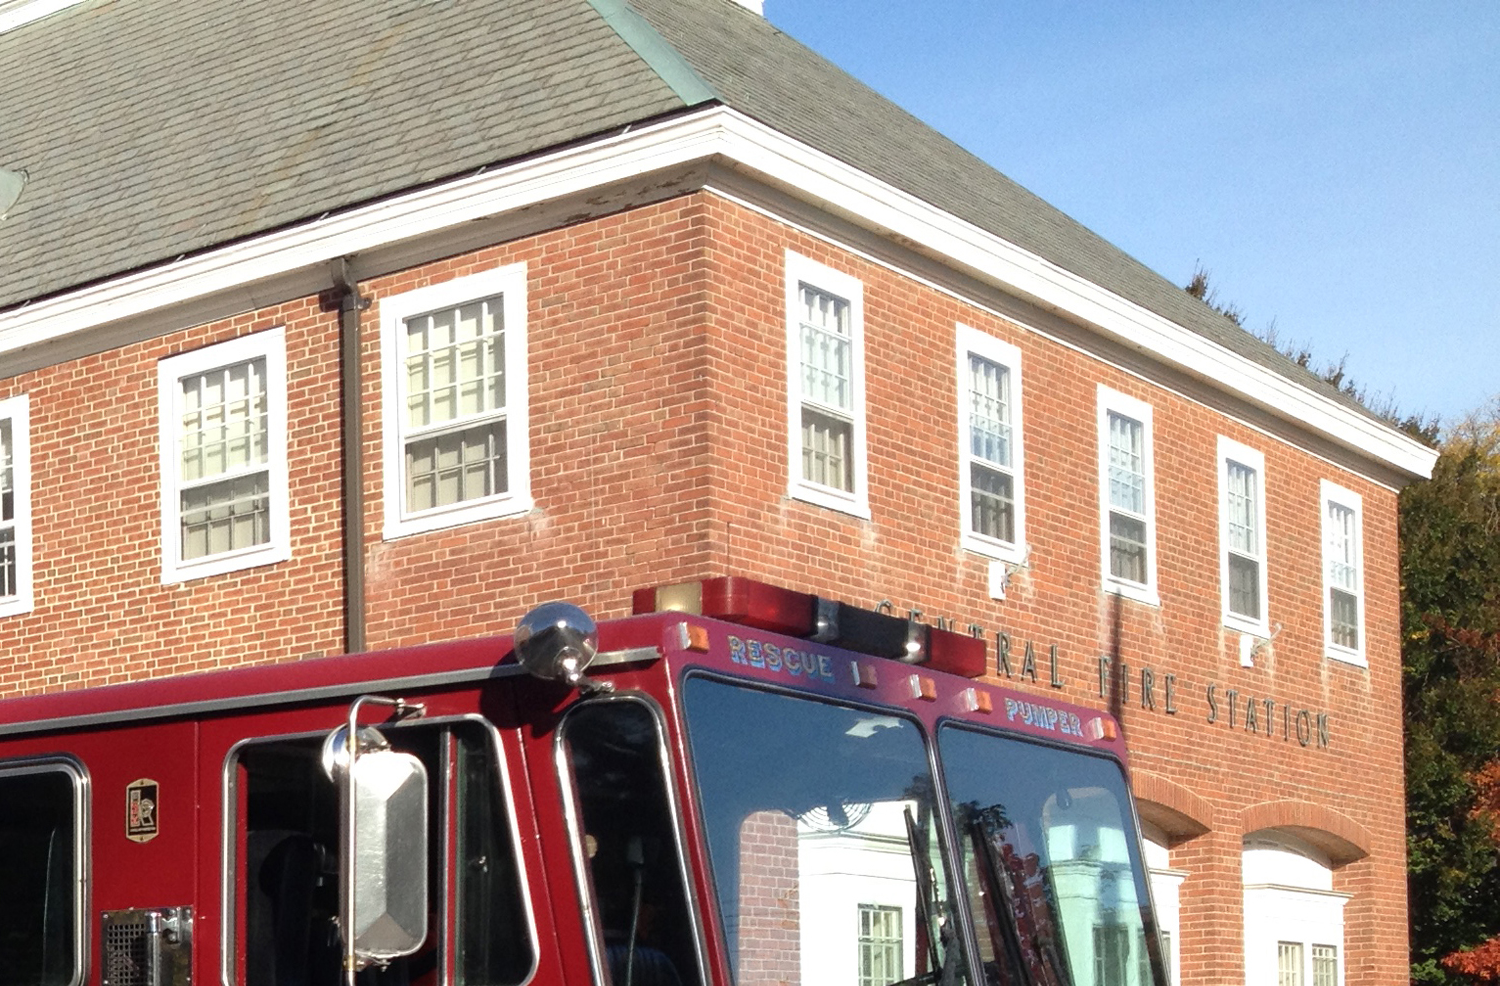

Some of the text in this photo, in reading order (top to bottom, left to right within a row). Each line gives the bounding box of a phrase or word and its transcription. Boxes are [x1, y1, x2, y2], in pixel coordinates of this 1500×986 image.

[728, 635, 835, 684] RESCUE
[1004, 697, 1084, 737] PUMPER
[1099, 655, 1178, 714] FIRE
[1206, 682, 1330, 749] STATION
